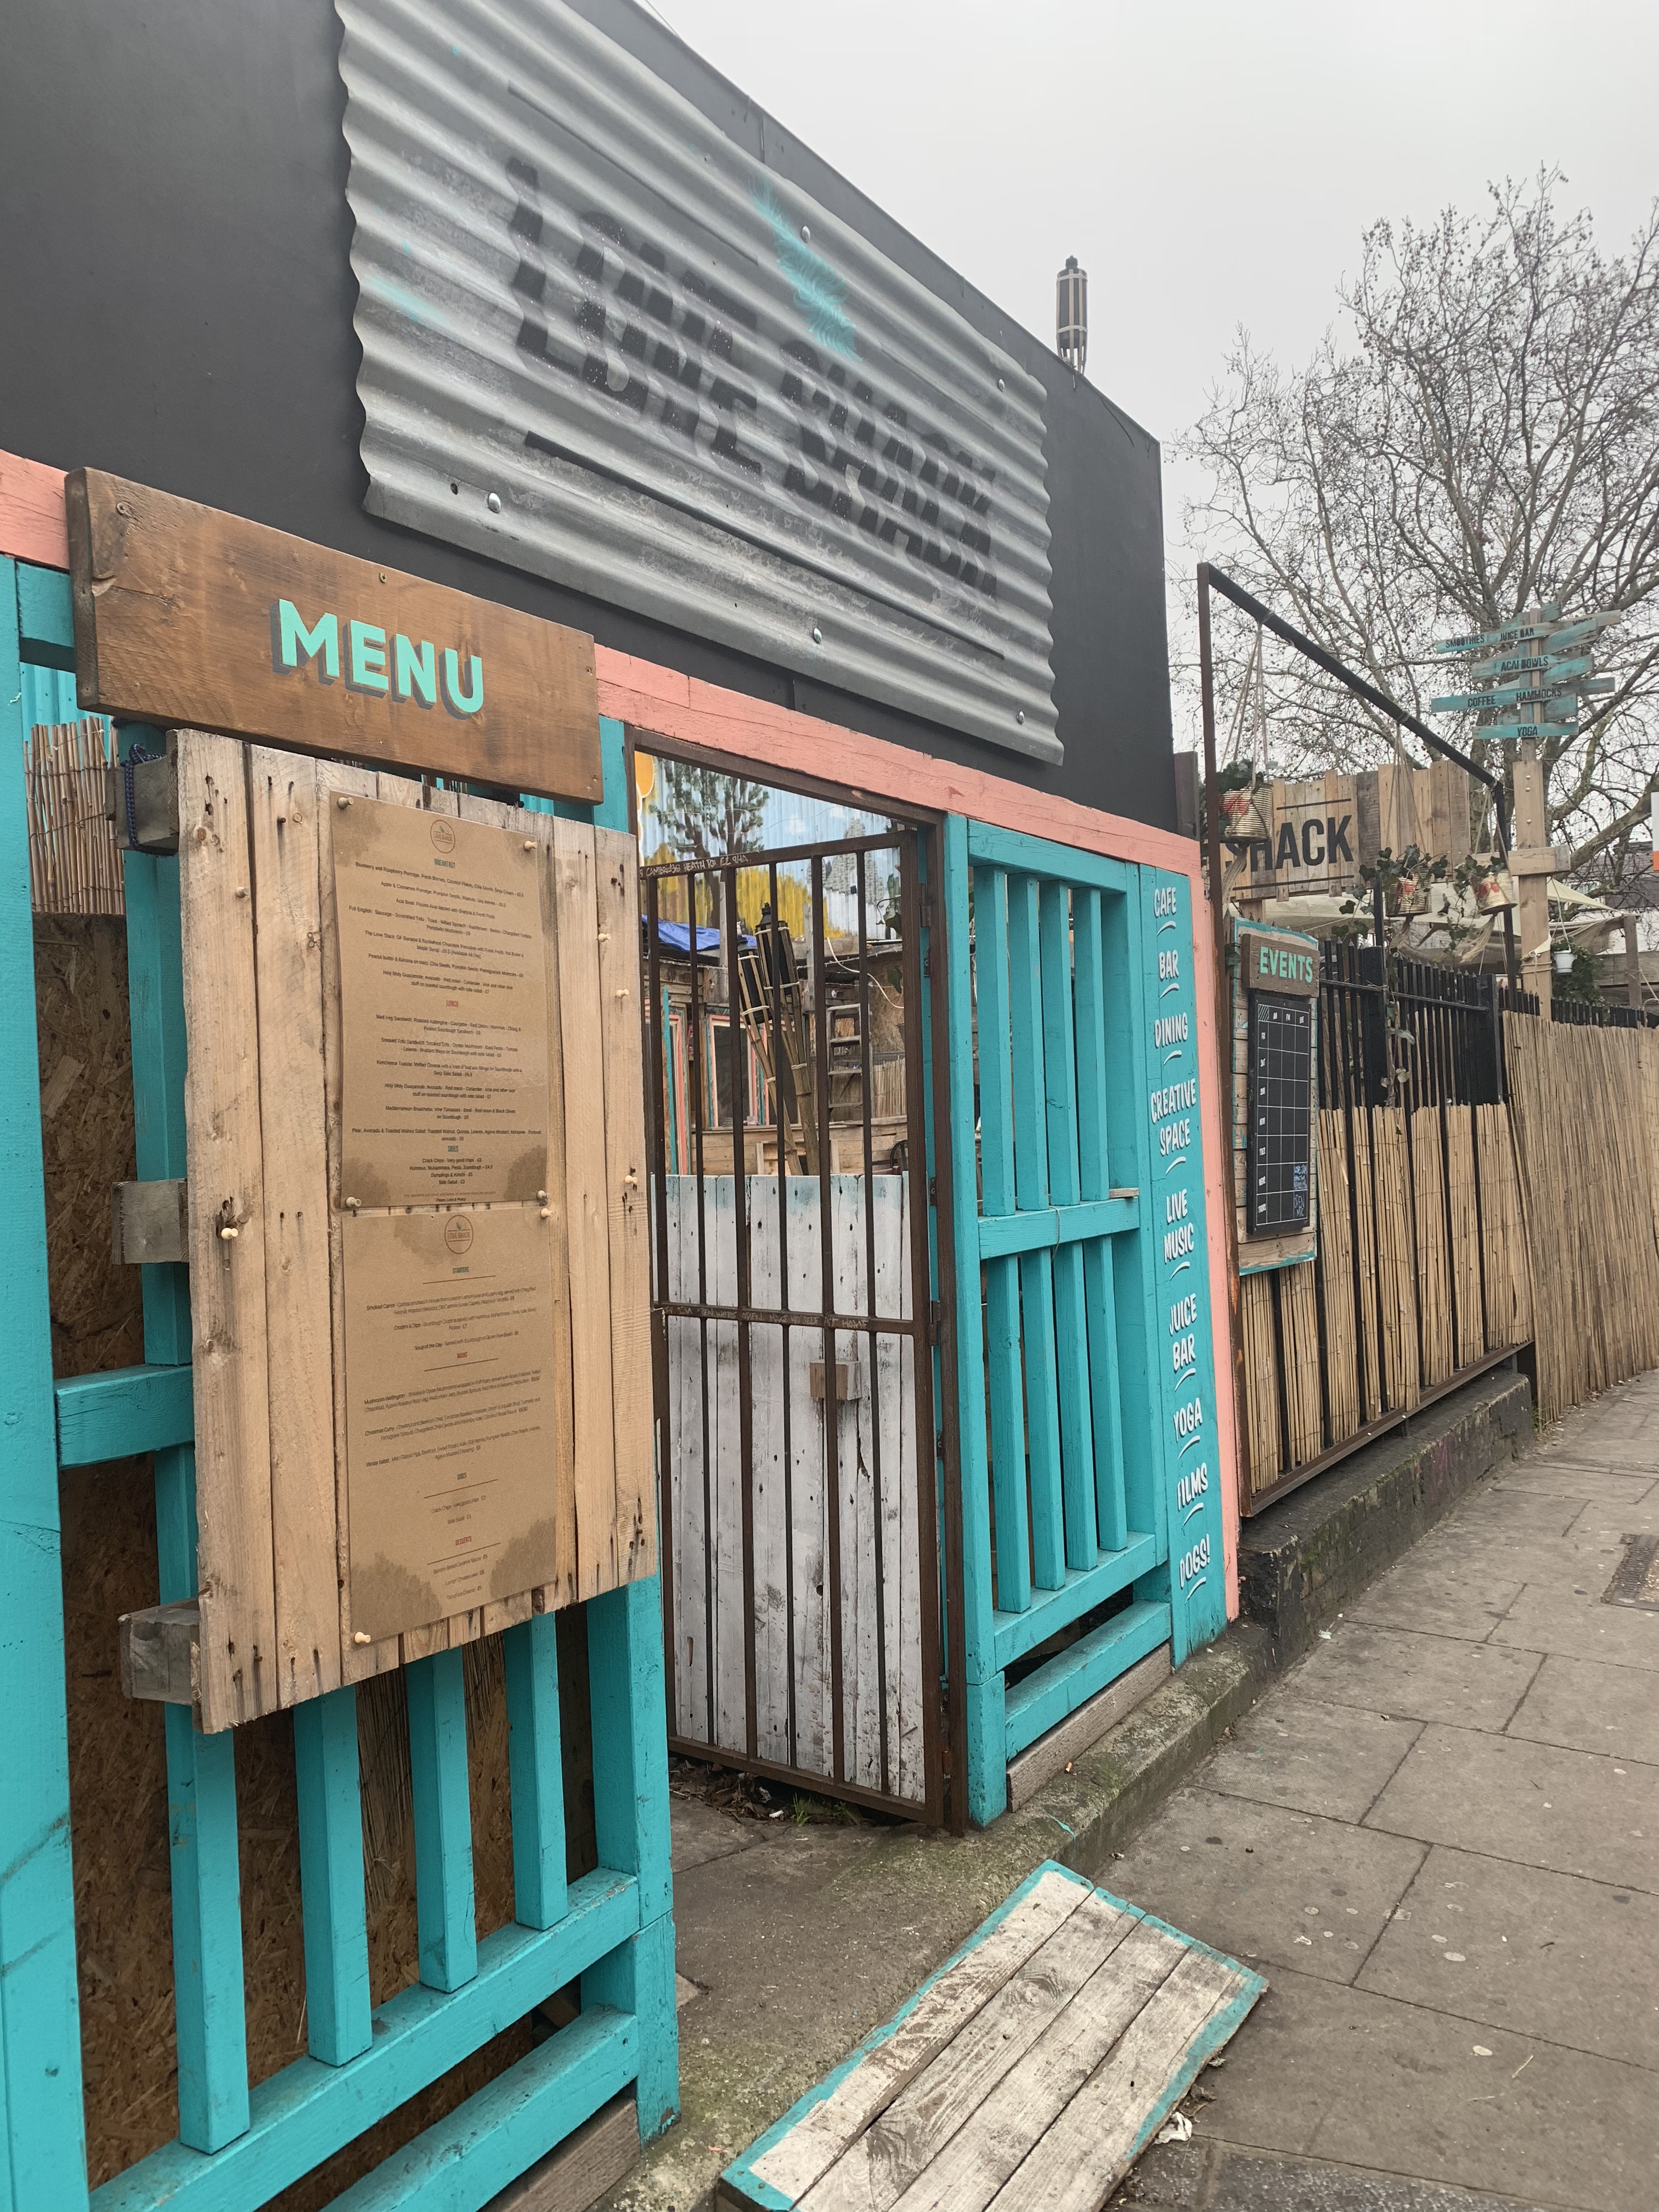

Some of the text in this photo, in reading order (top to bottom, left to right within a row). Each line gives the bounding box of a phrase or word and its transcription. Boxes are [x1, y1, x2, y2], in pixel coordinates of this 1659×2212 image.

[1446, 627, 1534, 648] SMOOTHIES JUICE BAR
[274, 598, 484, 718] MENU
[1501, 656, 1548, 672] ACAI BOWLS
[1468, 687, 1562, 708] COFFEE HAMMOCKS
[1517, 726, 1538, 737] YOGA
[434, 858, 455, 868] BREAKFAST
[720, 856, 731, 866] E2
[1154, 887, 1176, 919] CAFE
[1159, 949, 1179, 979] BAR
[1260, 947, 1313, 983] EVENTS
[1154, 1012, 1188, 1048] DINING
[1150, 1077, 1196, 1124] CREATIVE
[1160, 1118, 1190, 1157] SPACE
[1166, 1188, 1188, 1224] LIVE
[1164, 1223, 1194, 1264] MUSIC
[1169, 1293, 1197, 1336] JUICE
[1173, 1333, 1196, 1371] BAR
[1173, 1397, 1202, 1442] YOGA
[1177, 1462, 1209, 1512] FILMS
[455, 1536, 472, 1546] DESSERTS
[1180, 1534, 1211, 1590] DOGS!
